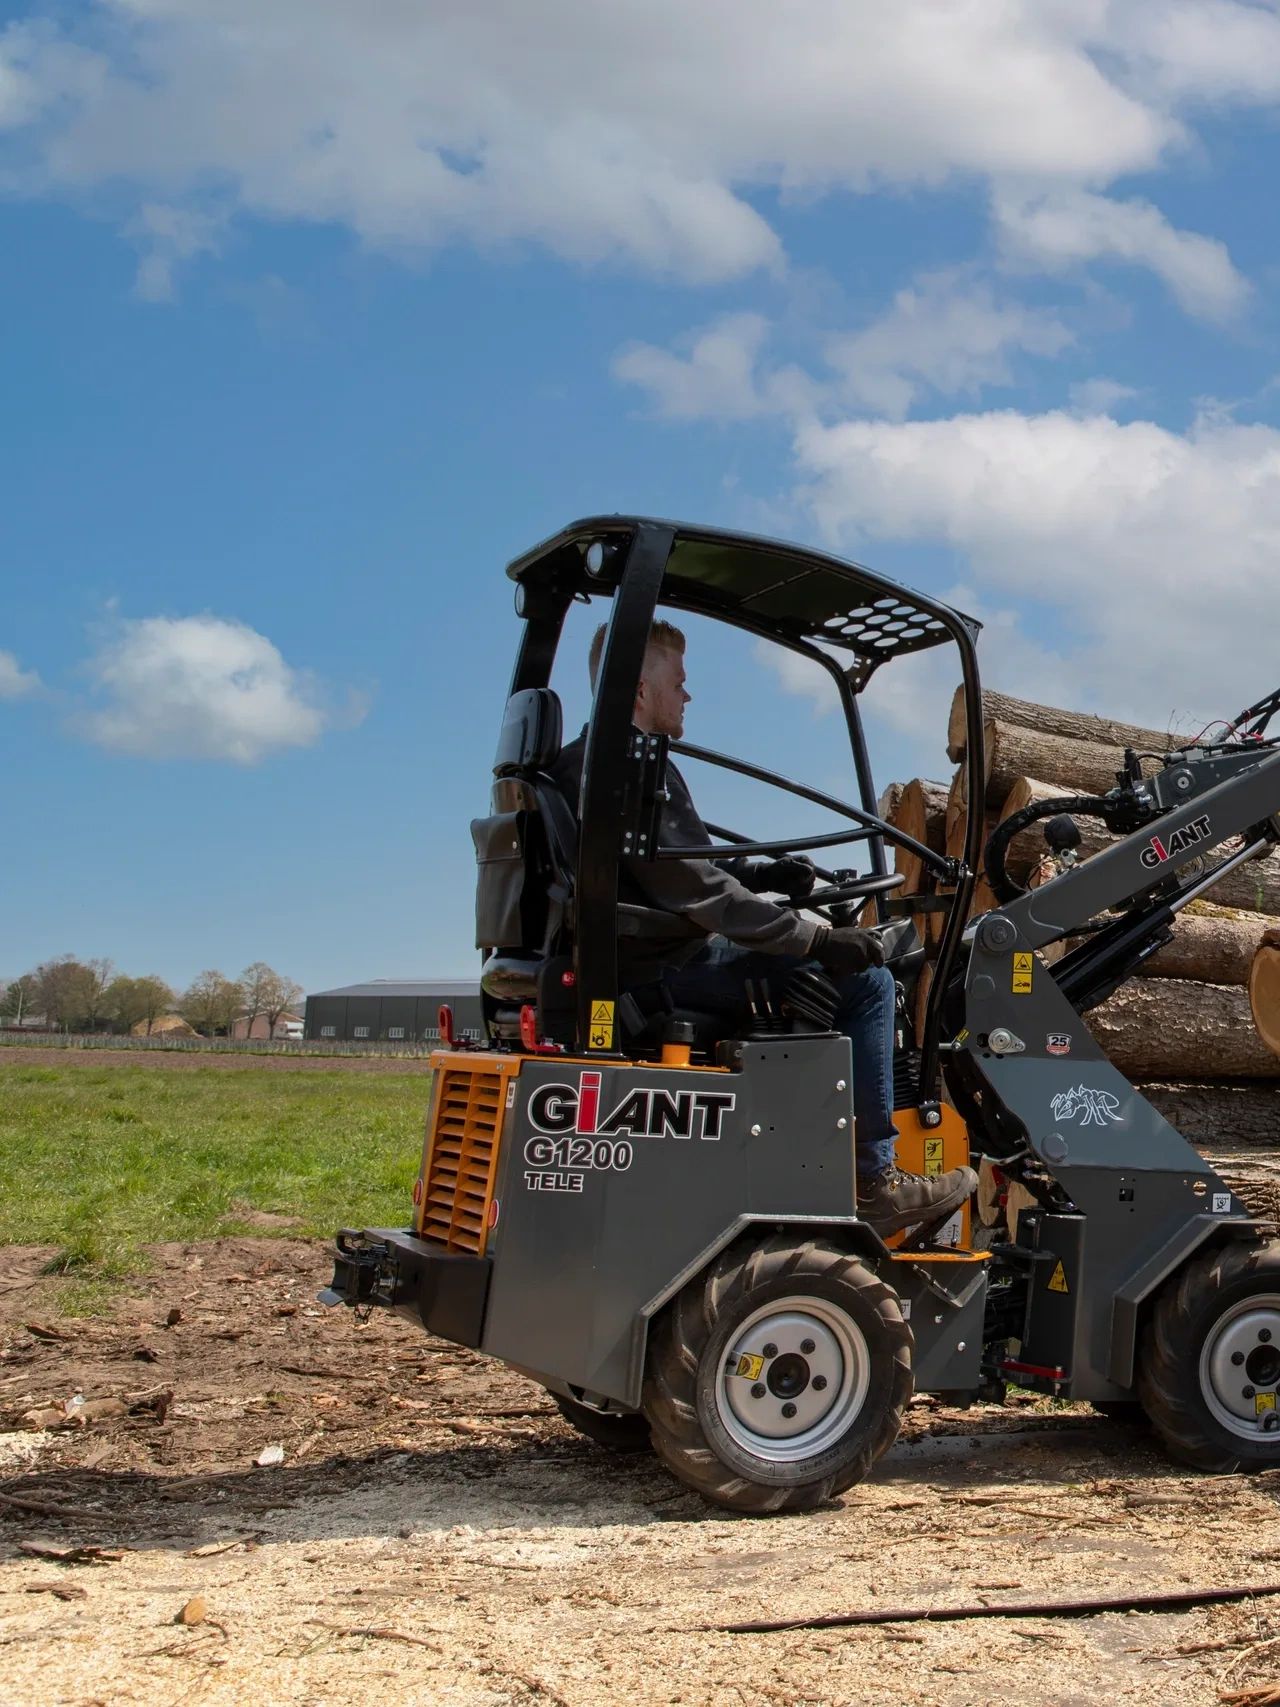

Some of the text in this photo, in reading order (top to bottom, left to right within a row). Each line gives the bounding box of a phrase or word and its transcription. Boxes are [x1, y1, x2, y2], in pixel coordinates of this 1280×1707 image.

[1051, 1036, 1067, 1046] 25
[524, 1136, 632, 1170] G1200
[524, 1171, 584, 1192] TELE
